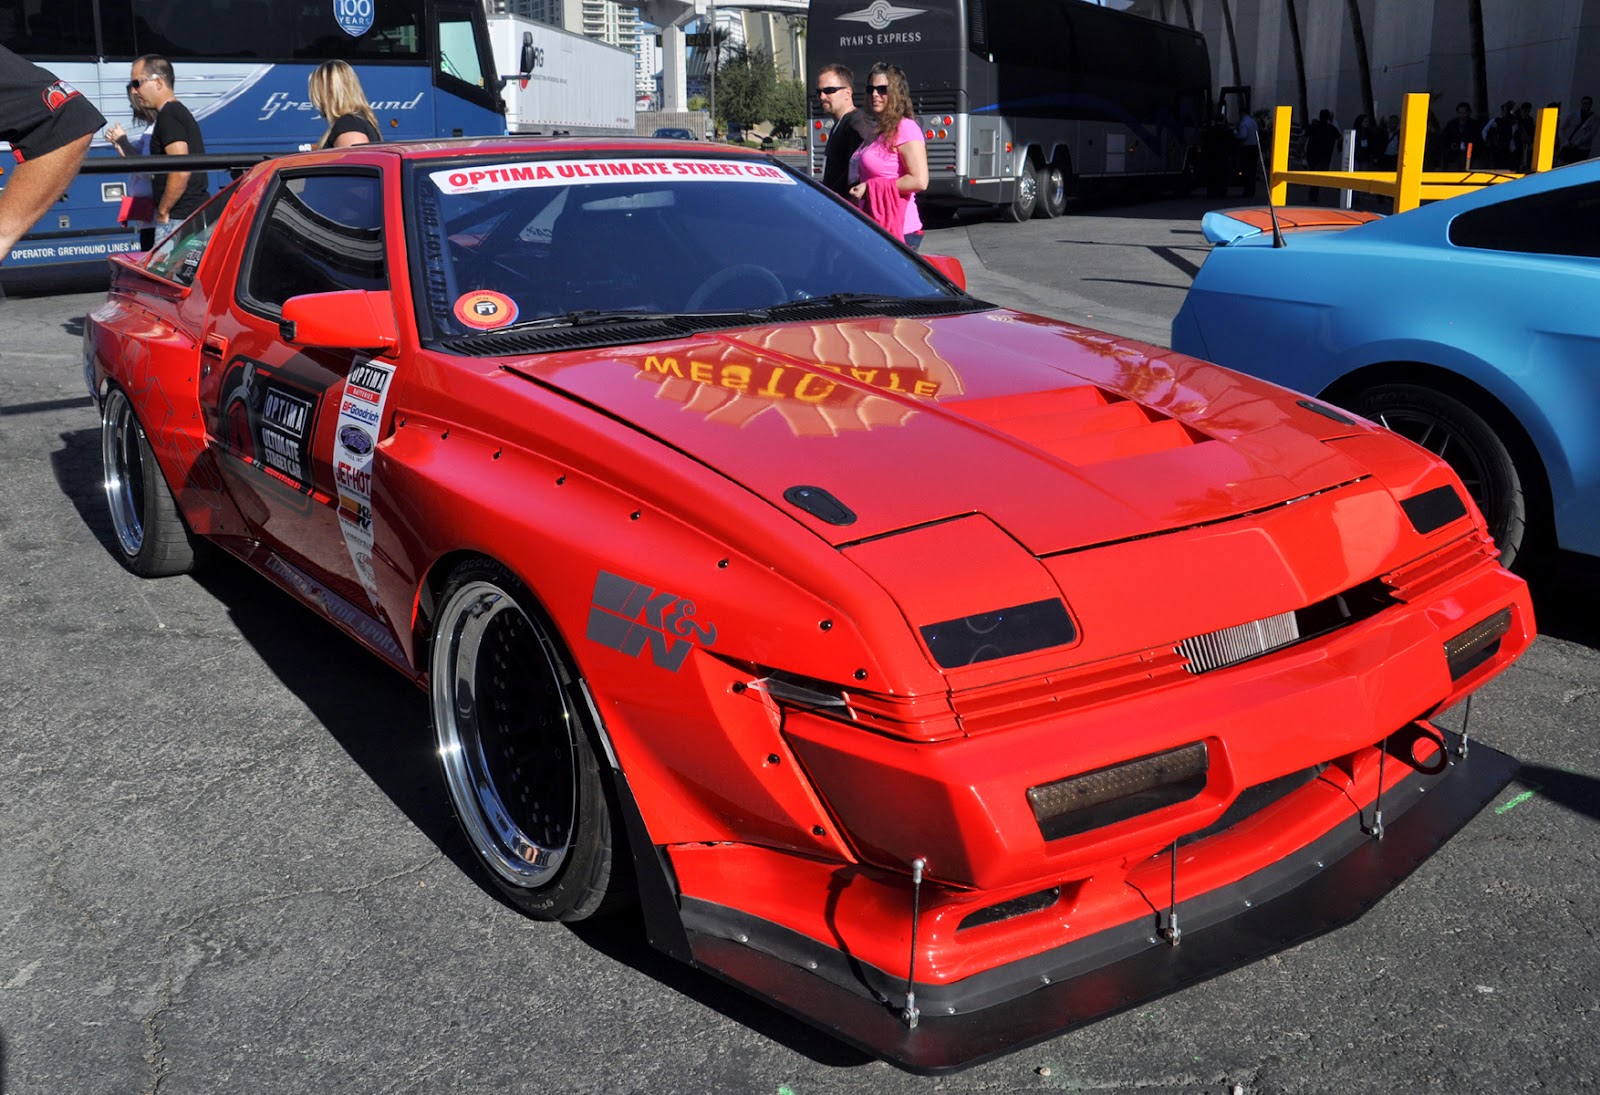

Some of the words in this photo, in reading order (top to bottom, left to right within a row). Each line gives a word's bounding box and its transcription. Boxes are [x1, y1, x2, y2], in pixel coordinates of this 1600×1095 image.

[338, 16, 371, 25] YEARS
[339, 0, 371, 17] 100
[840, 35, 873, 47] RYAN'S
[877, 32, 921, 45] EXPRESS
[258, 92, 424, 121] Greund
[448, 165, 554, 187] OPTIMA
[556, 162, 672, 178] ULTIMATE
[672, 162, 744, 176] STREET
[744, 165, 785, 179] CAR
[12, 248, 56, 259] OPERATOR:
[58, 244, 106, 257] GREYHOUND
[107, 243, 129, 252] LINES
[351, 365, 386, 390] OPTIMA
[264, 394, 305, 432] OPTIMA
[342, 401, 379, 422] BFGoodrich
[262, 427, 300, 462] ULTIMATE
[336, 460, 371, 496] JET-HOT
[618, 582, 717, 673] K&N
